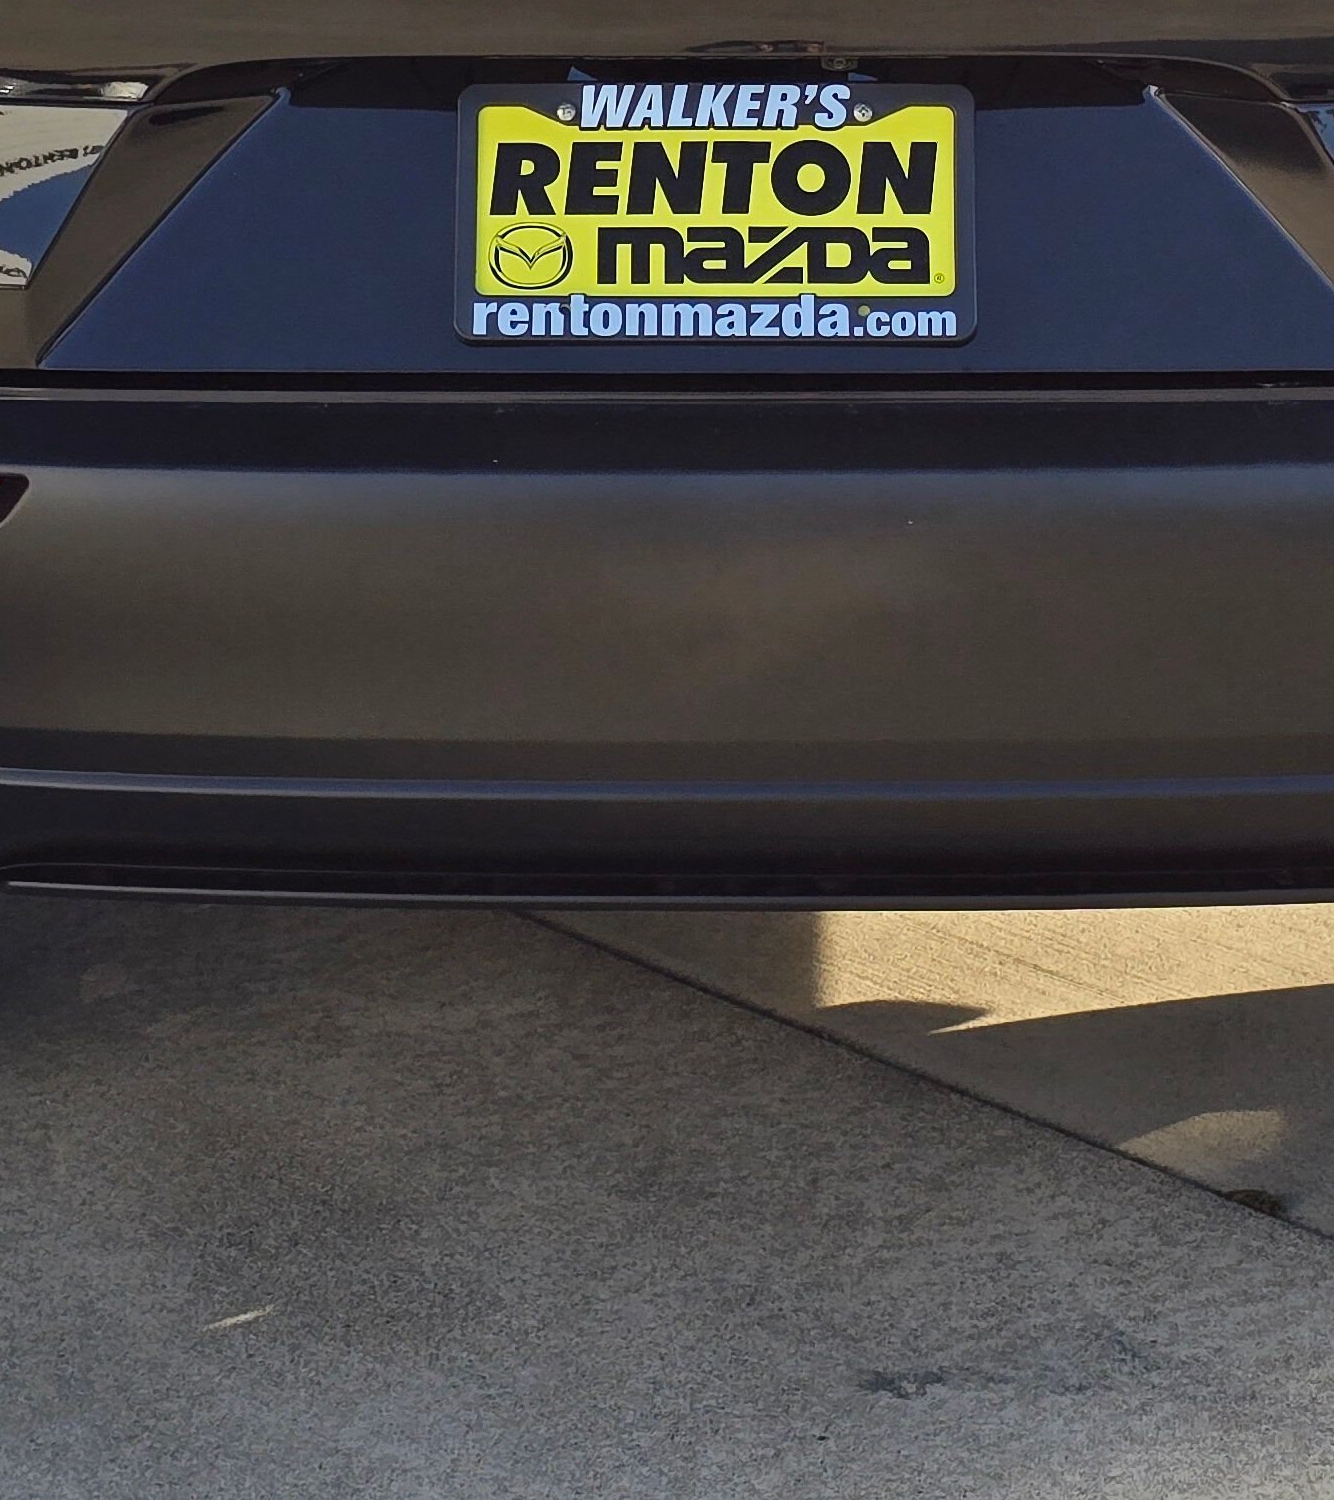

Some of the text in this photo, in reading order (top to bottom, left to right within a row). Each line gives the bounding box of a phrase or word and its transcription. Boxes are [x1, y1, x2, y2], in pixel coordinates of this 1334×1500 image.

[580, 84, 852, 128] WALKER'S
[489, 139, 938, 216] RENTON
[597, 226, 931, 285] mazda
[472, 295, 957, 337] rentonmazda.com
